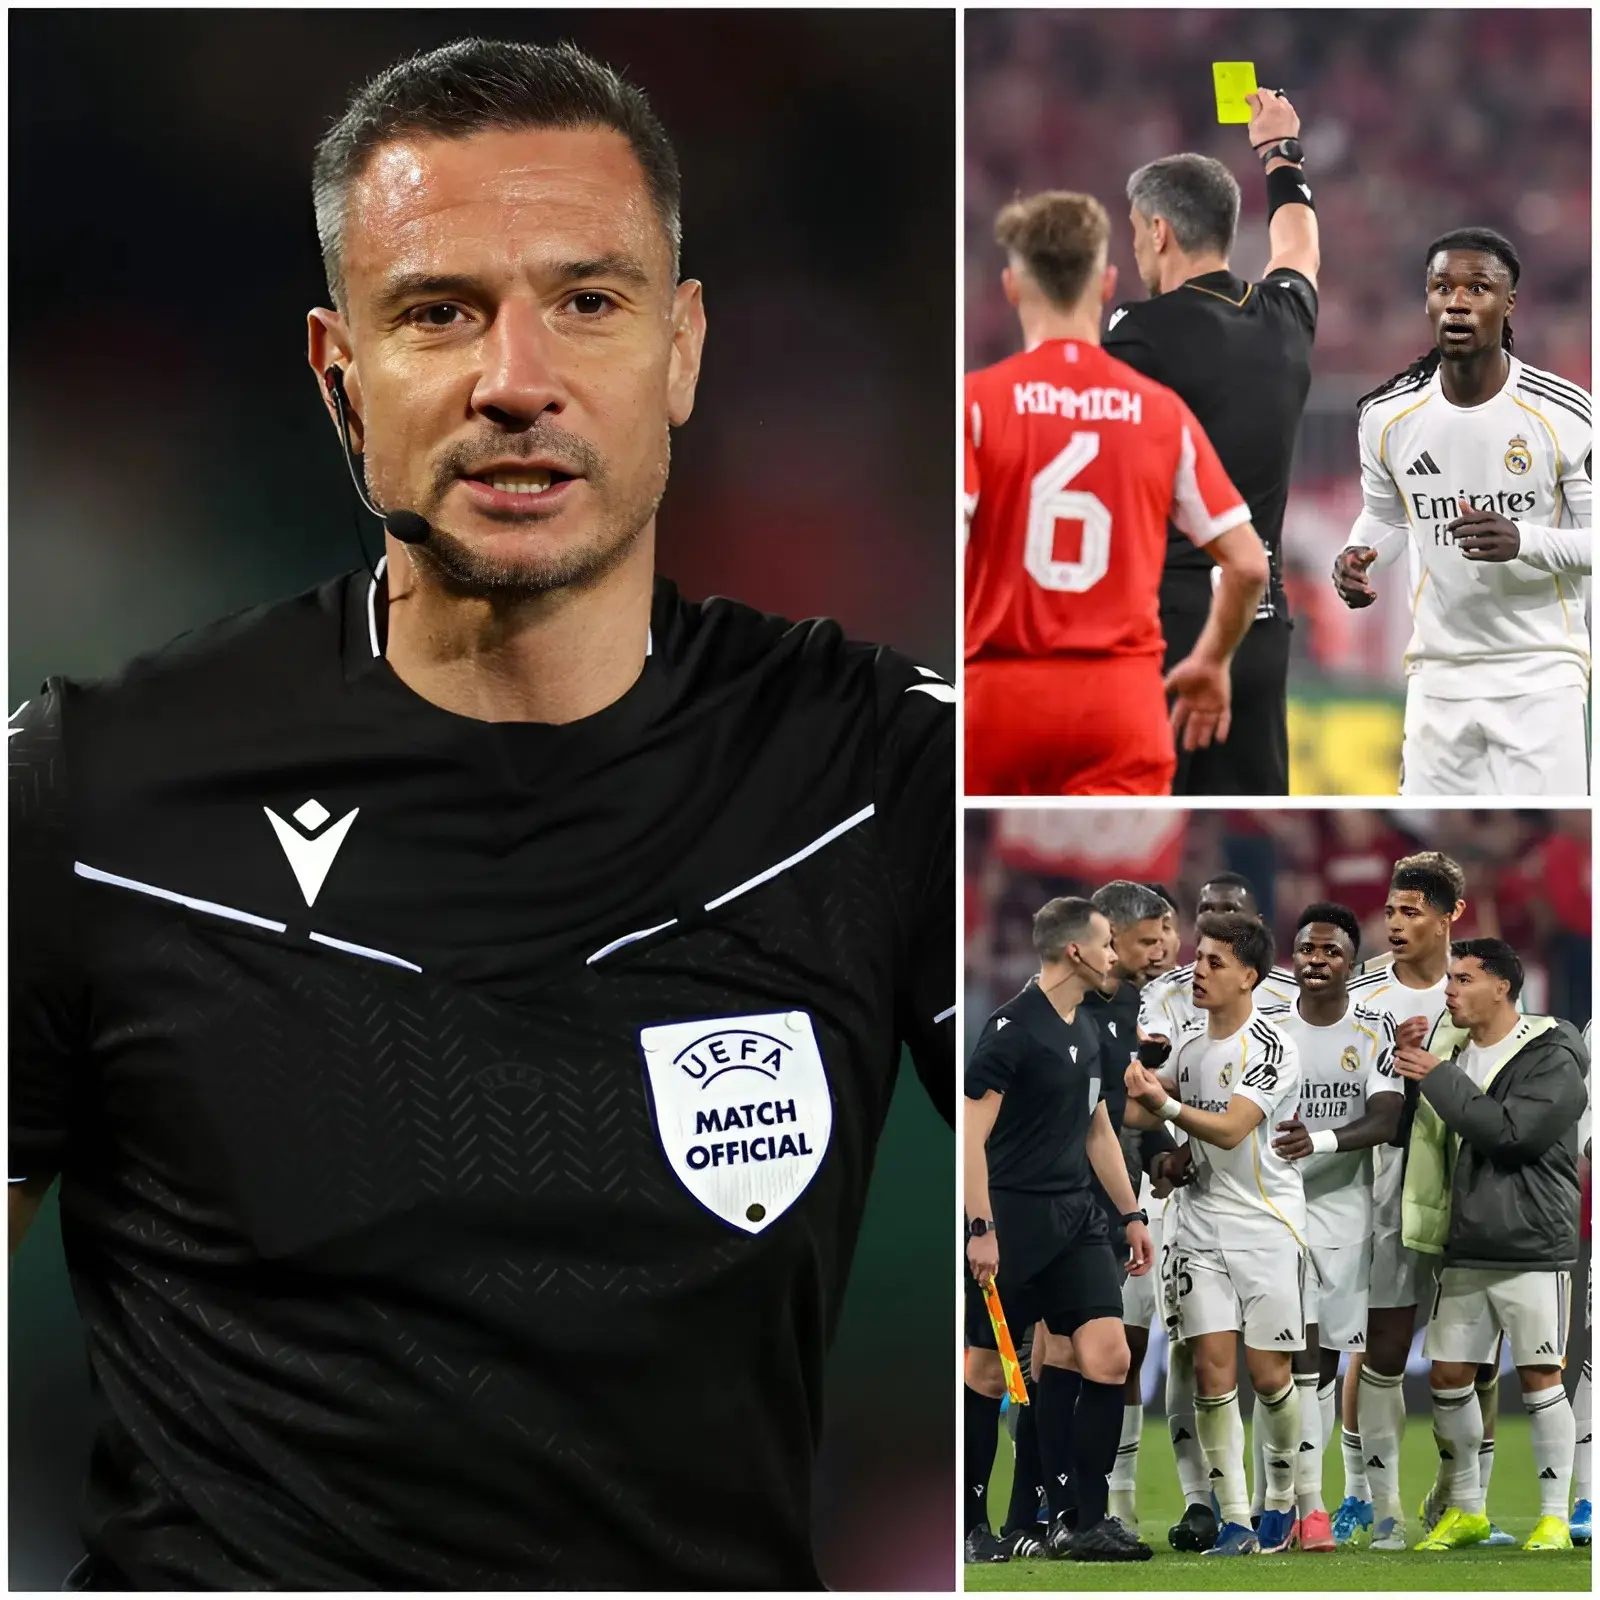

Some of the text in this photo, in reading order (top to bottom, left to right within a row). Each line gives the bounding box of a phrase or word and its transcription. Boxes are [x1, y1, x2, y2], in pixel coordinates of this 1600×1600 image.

[1013, 382, 1142, 425] KIMMICH
[1024, 431, 1112, 593] 6
[681, 1038, 782, 1079] UEFA
[696, 1099, 798, 1134] MATCH
[686, 1132, 813, 1171] OFFICIAL
